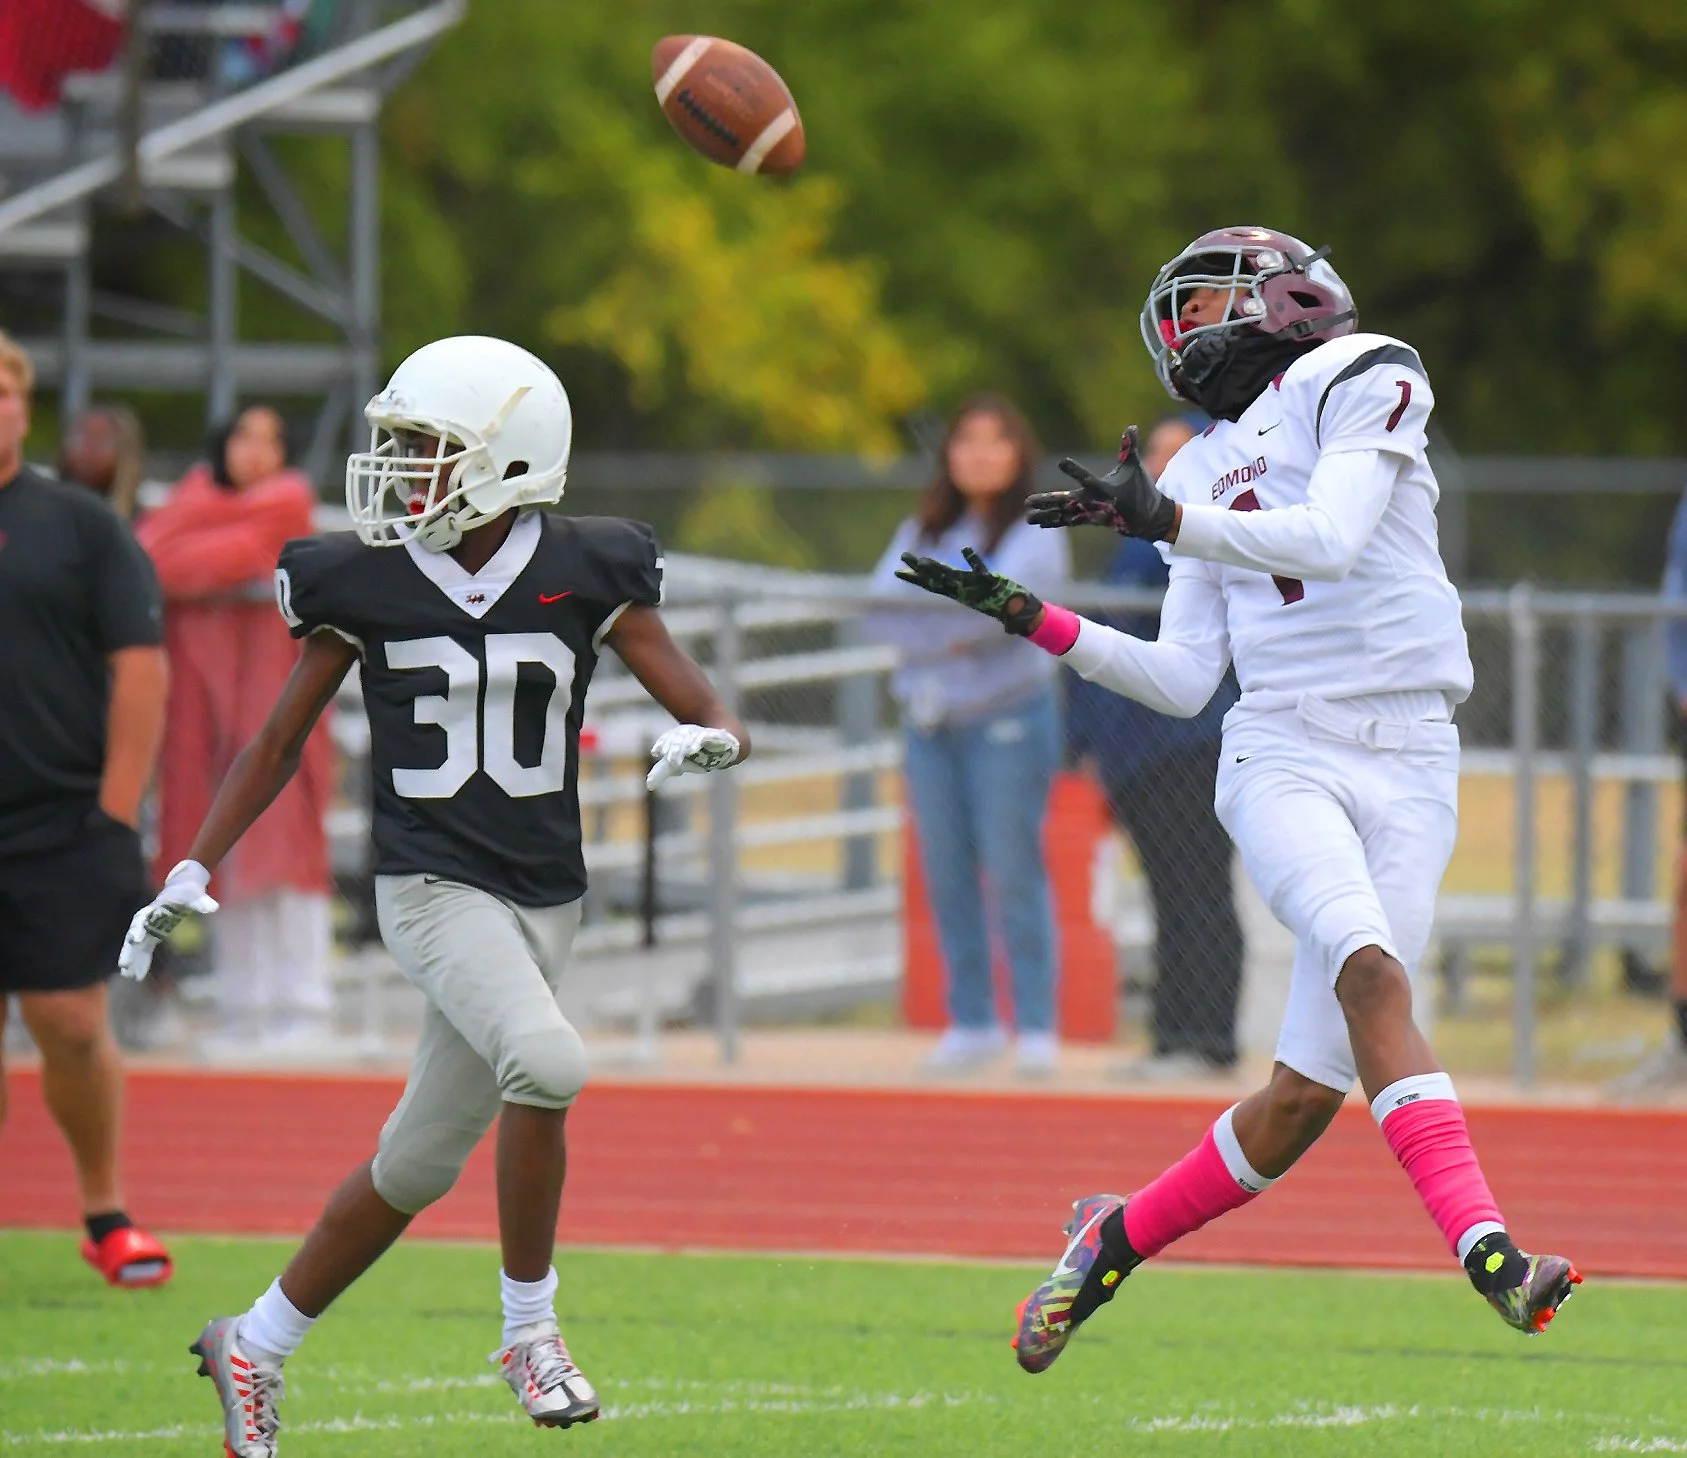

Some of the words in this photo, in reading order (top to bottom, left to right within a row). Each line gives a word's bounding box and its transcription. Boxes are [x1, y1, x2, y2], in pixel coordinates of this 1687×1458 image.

[1385, 381, 1412, 433] 1
[1211, 456, 1267, 501] EDMOND
[384, 632, 576, 798] 30
